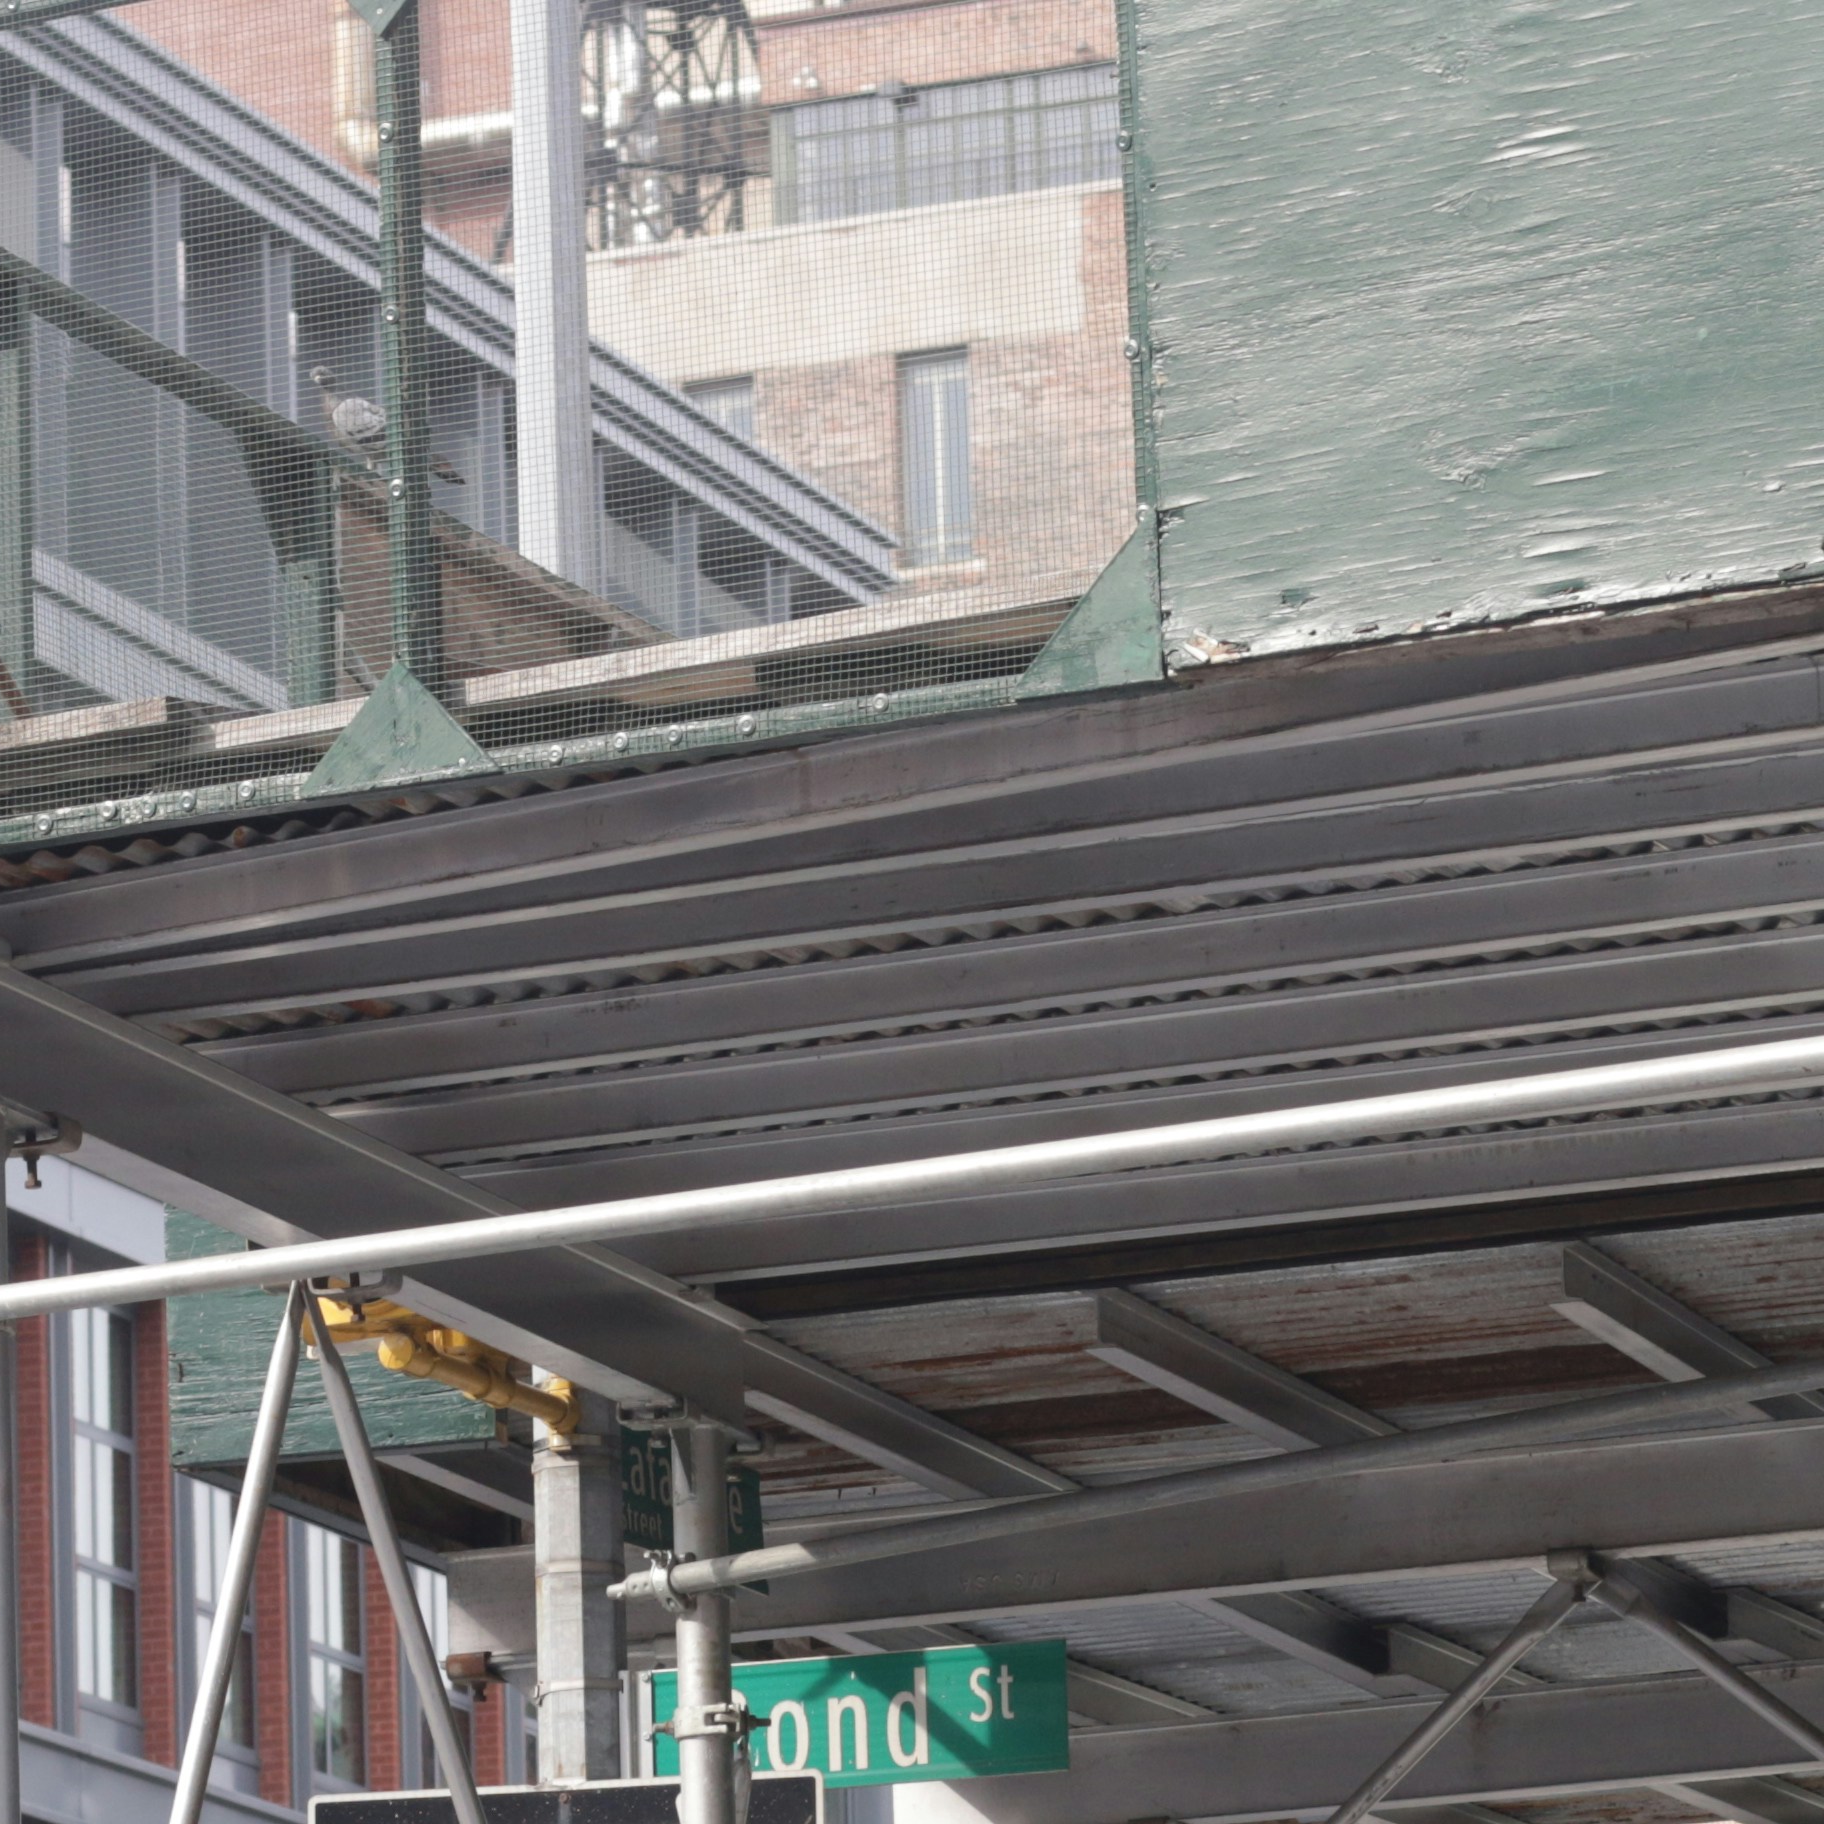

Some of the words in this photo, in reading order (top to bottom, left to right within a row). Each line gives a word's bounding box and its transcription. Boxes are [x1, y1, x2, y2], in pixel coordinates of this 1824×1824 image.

[623, 1503, 664, 1541] treet
[732, 1666, 930, 1772] ond
[969, 1664, 1015, 1722] St
